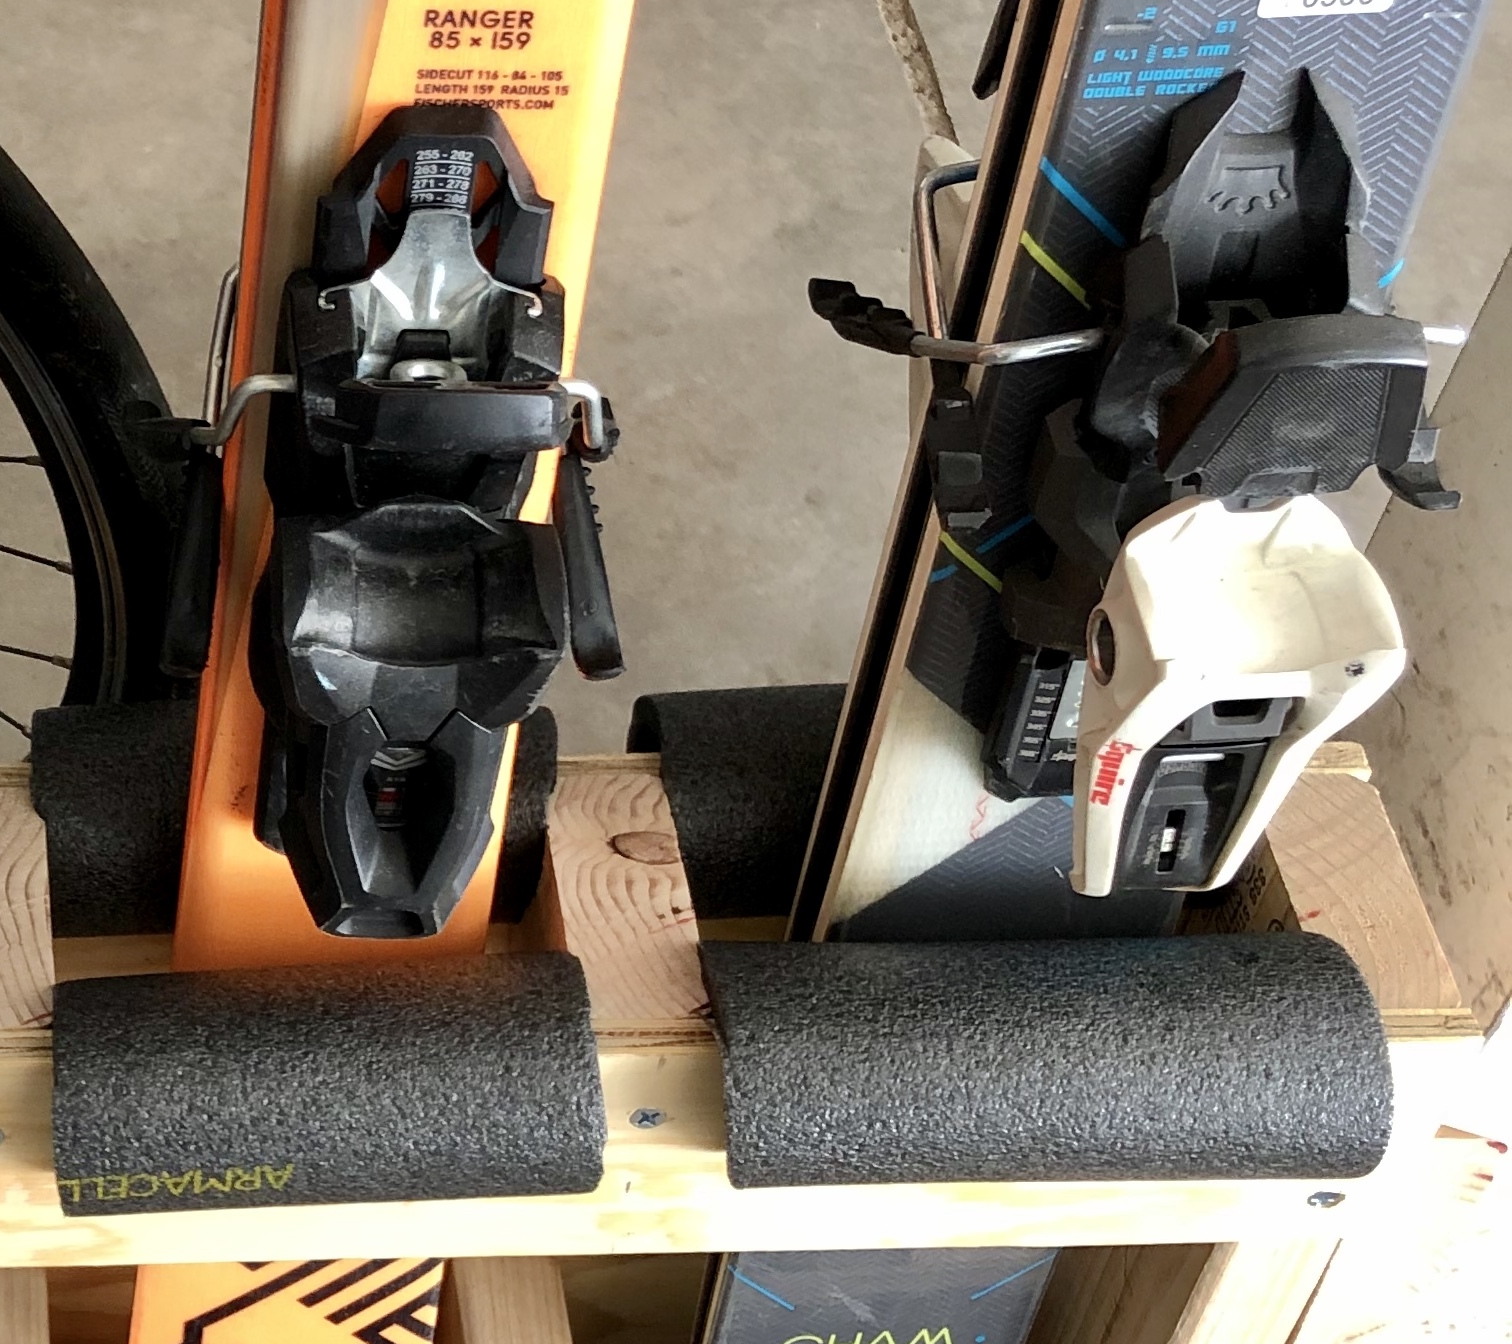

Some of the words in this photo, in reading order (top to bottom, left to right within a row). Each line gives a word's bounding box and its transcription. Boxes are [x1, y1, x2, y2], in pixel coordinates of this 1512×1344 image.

[423, 9, 535, 30] RANGER
[429, 31, 461, 50] 85
[490, 31, 532, 51] 159
[416, 69, 474, 80] SIDECUT
[1087, 70, 1133, 86] LIGHT
[1137, 66, 1225, 83] WOODCORE
[414, 84, 469, 95] LENGTH
[500, 85, 550, 96] RADIUS
[1083, 83, 1147, 100] DOUBLE
[1090, 740, 1138, 806] Squire
[58, 1164, 294, 1203] ARMACELL
